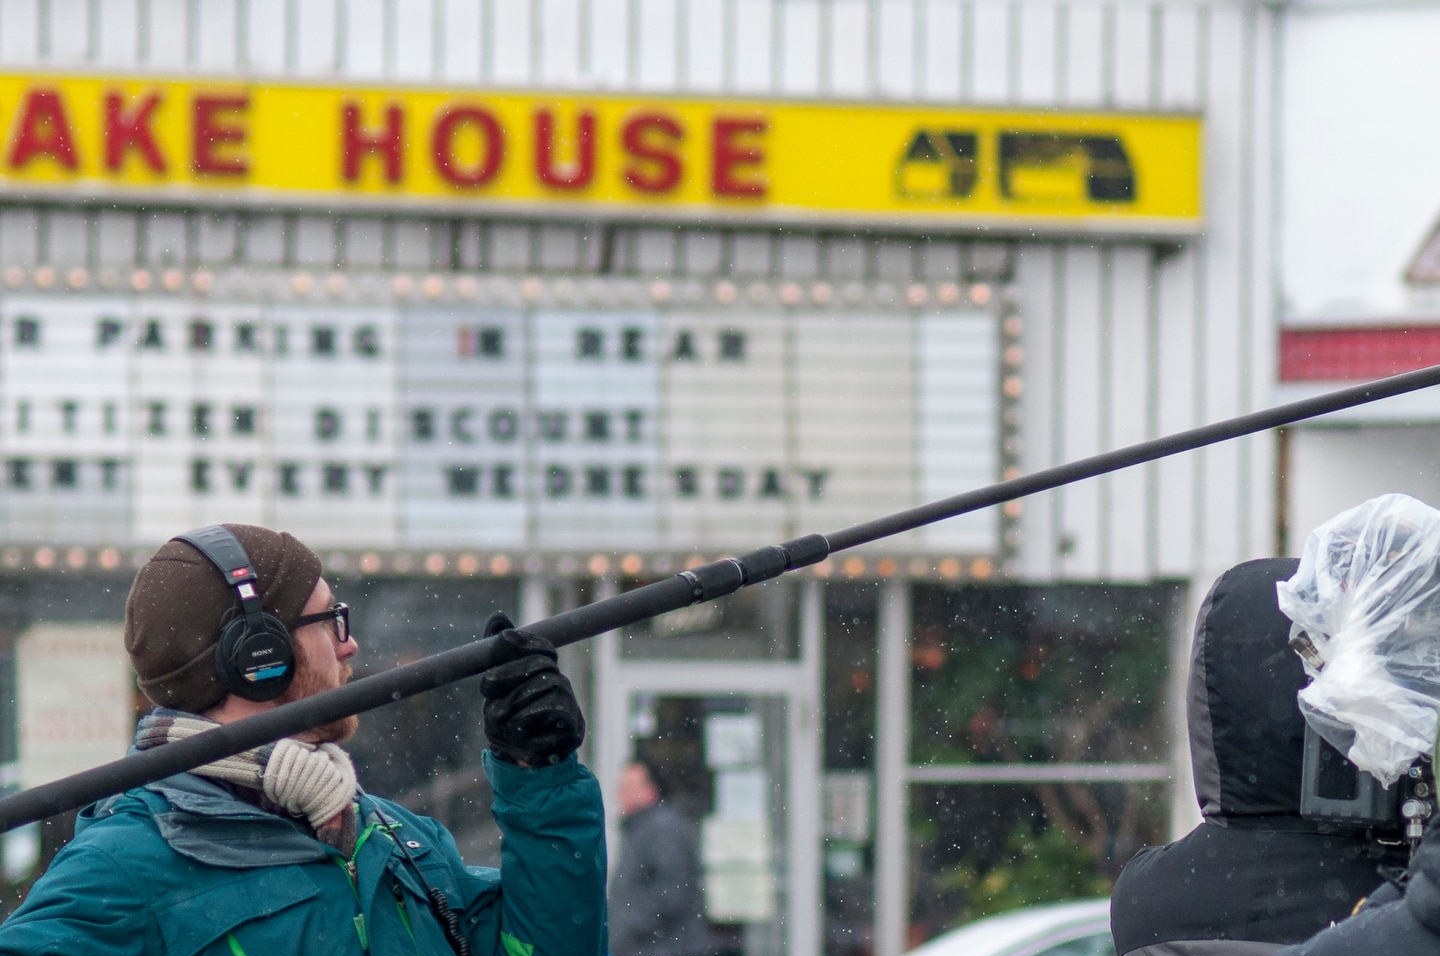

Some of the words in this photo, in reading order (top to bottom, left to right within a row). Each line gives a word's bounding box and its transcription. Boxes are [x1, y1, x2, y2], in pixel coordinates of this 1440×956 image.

[6, 86, 252, 177] AKE
[339, 101, 770, 198] HOUSE
[96, 316, 383, 360] PARKING
[576, 327, 747, 364] REAR
[16, 400, 257, 437] ITIZEN
[314, 405, 645, 445] DISCOUNT
[190, 456, 389, 497] EVERY
[251, 648, 273, 657] SONY
